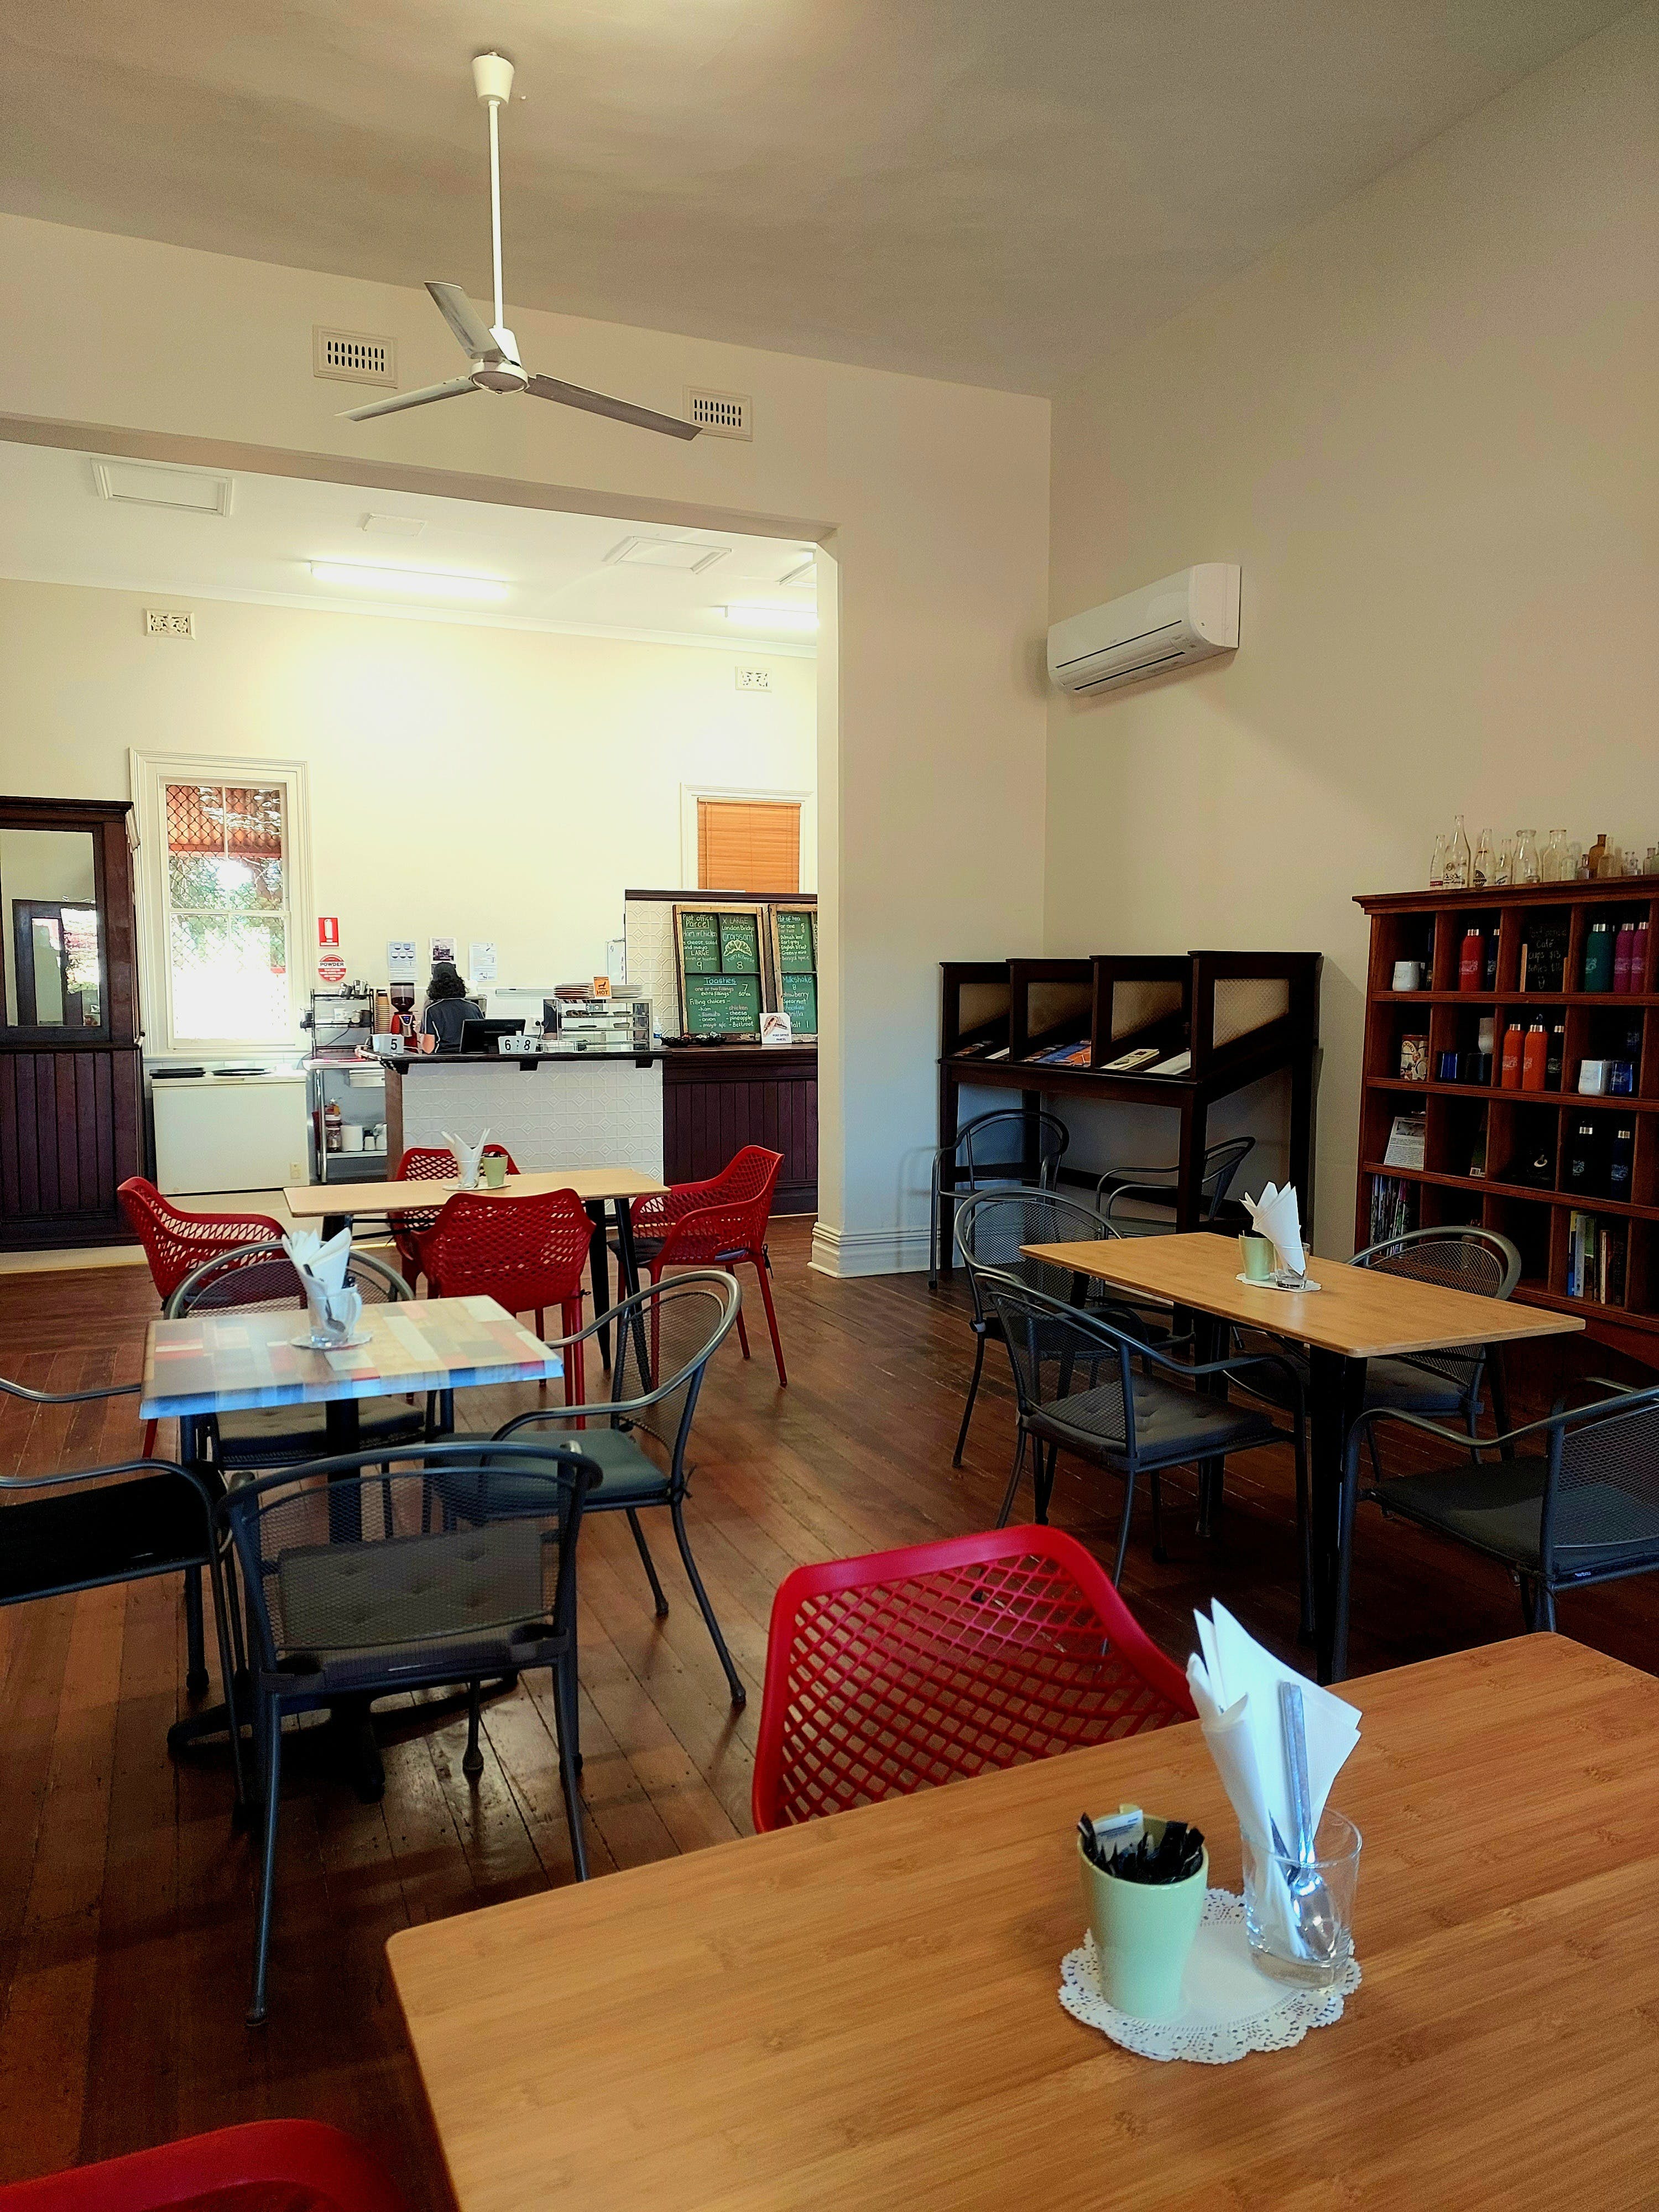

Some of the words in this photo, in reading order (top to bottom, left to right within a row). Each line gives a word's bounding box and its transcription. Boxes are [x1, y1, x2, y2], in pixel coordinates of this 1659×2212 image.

[723, 933, 753, 942] Croissant
[696, 961, 702, 971] 9
[737, 961, 743, 970] 8
[390, 1039, 398, 1050] 5
[505, 1039, 511, 1051] 6
[524, 1039, 531, 1051] 8
